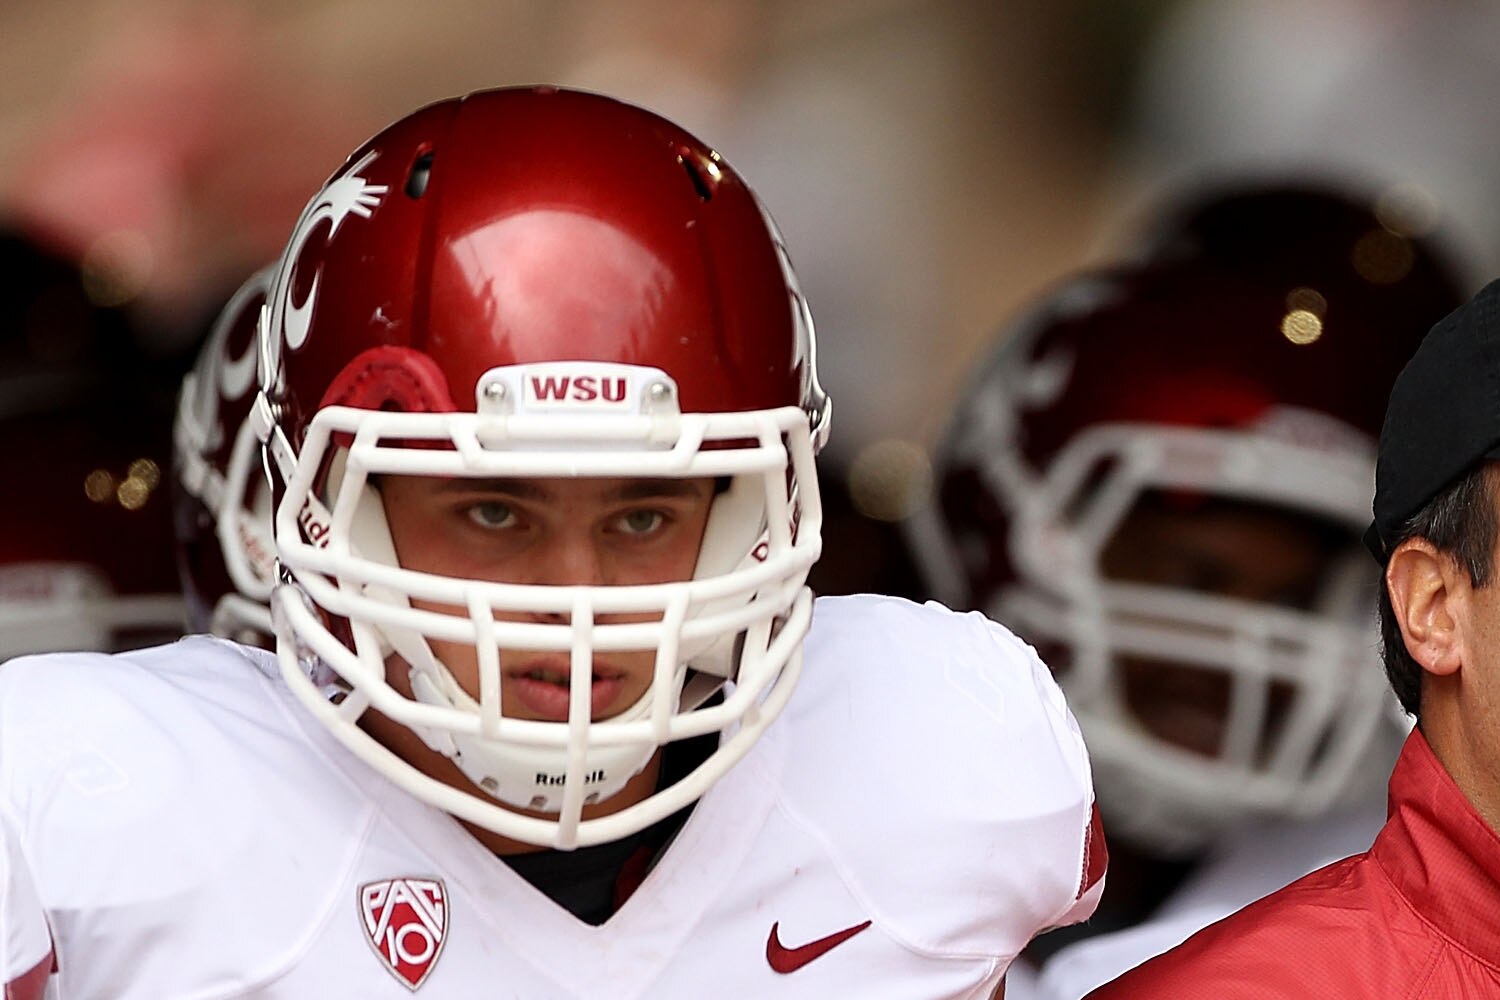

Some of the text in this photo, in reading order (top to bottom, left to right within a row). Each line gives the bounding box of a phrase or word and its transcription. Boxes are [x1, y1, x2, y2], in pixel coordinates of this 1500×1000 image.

[531, 376, 627, 402] WSU
[536, 769, 606, 785] Ridll
[361, 879, 444, 947] PAC
[386, 922, 436, 967] 10
